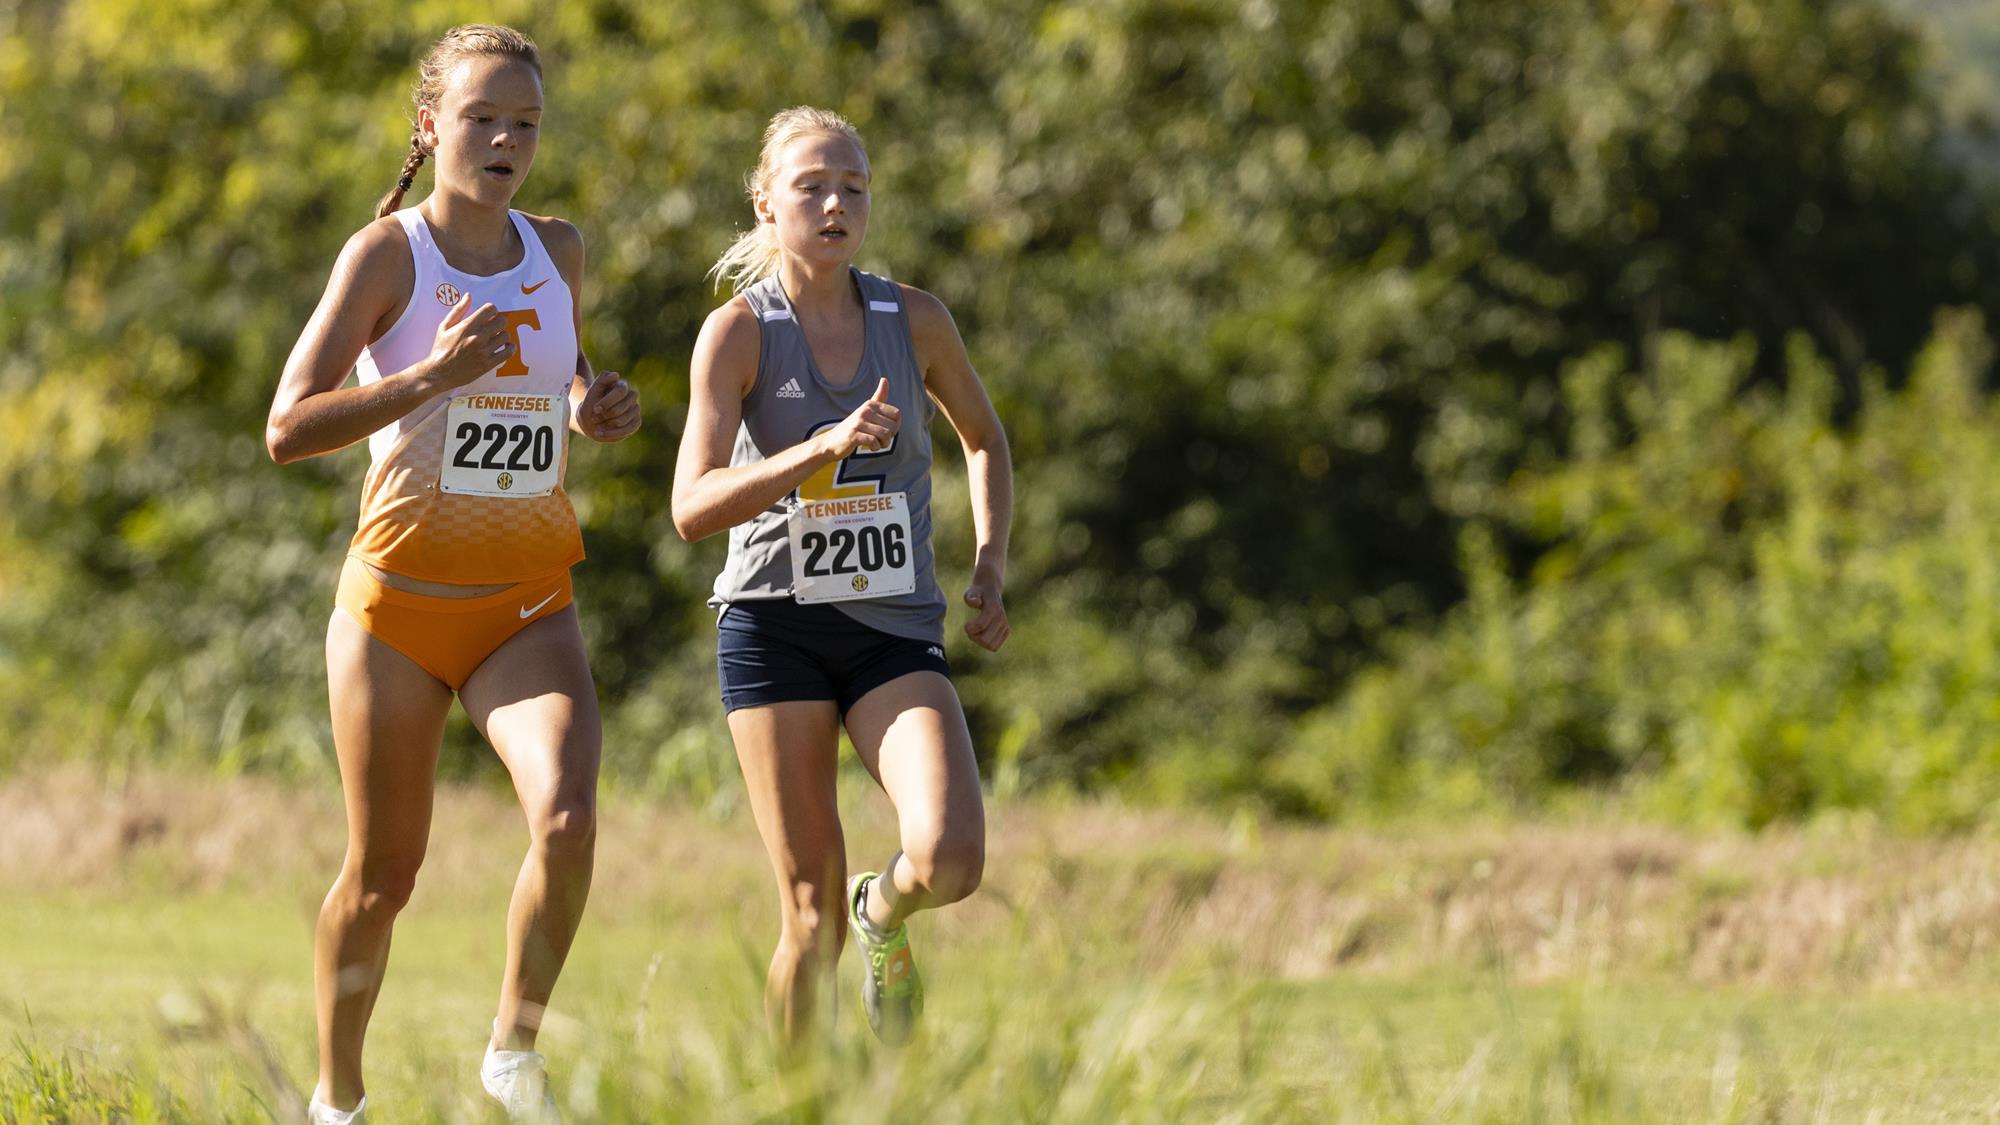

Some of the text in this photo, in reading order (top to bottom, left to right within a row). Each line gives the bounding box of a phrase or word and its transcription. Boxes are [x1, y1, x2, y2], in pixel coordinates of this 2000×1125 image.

[436, 283, 460, 306] SEC
[495, 308, 542, 378] T
[466, 396, 551, 412] TENNESSEE
[776, 390, 805, 398] adidas
[452, 422, 554, 472] 2220
[497, 471, 513, 490] SEC
[804, 496, 893, 519] TENNESSEE
[801, 522, 906, 578] 2206
[851, 574, 869, 592] SEC
